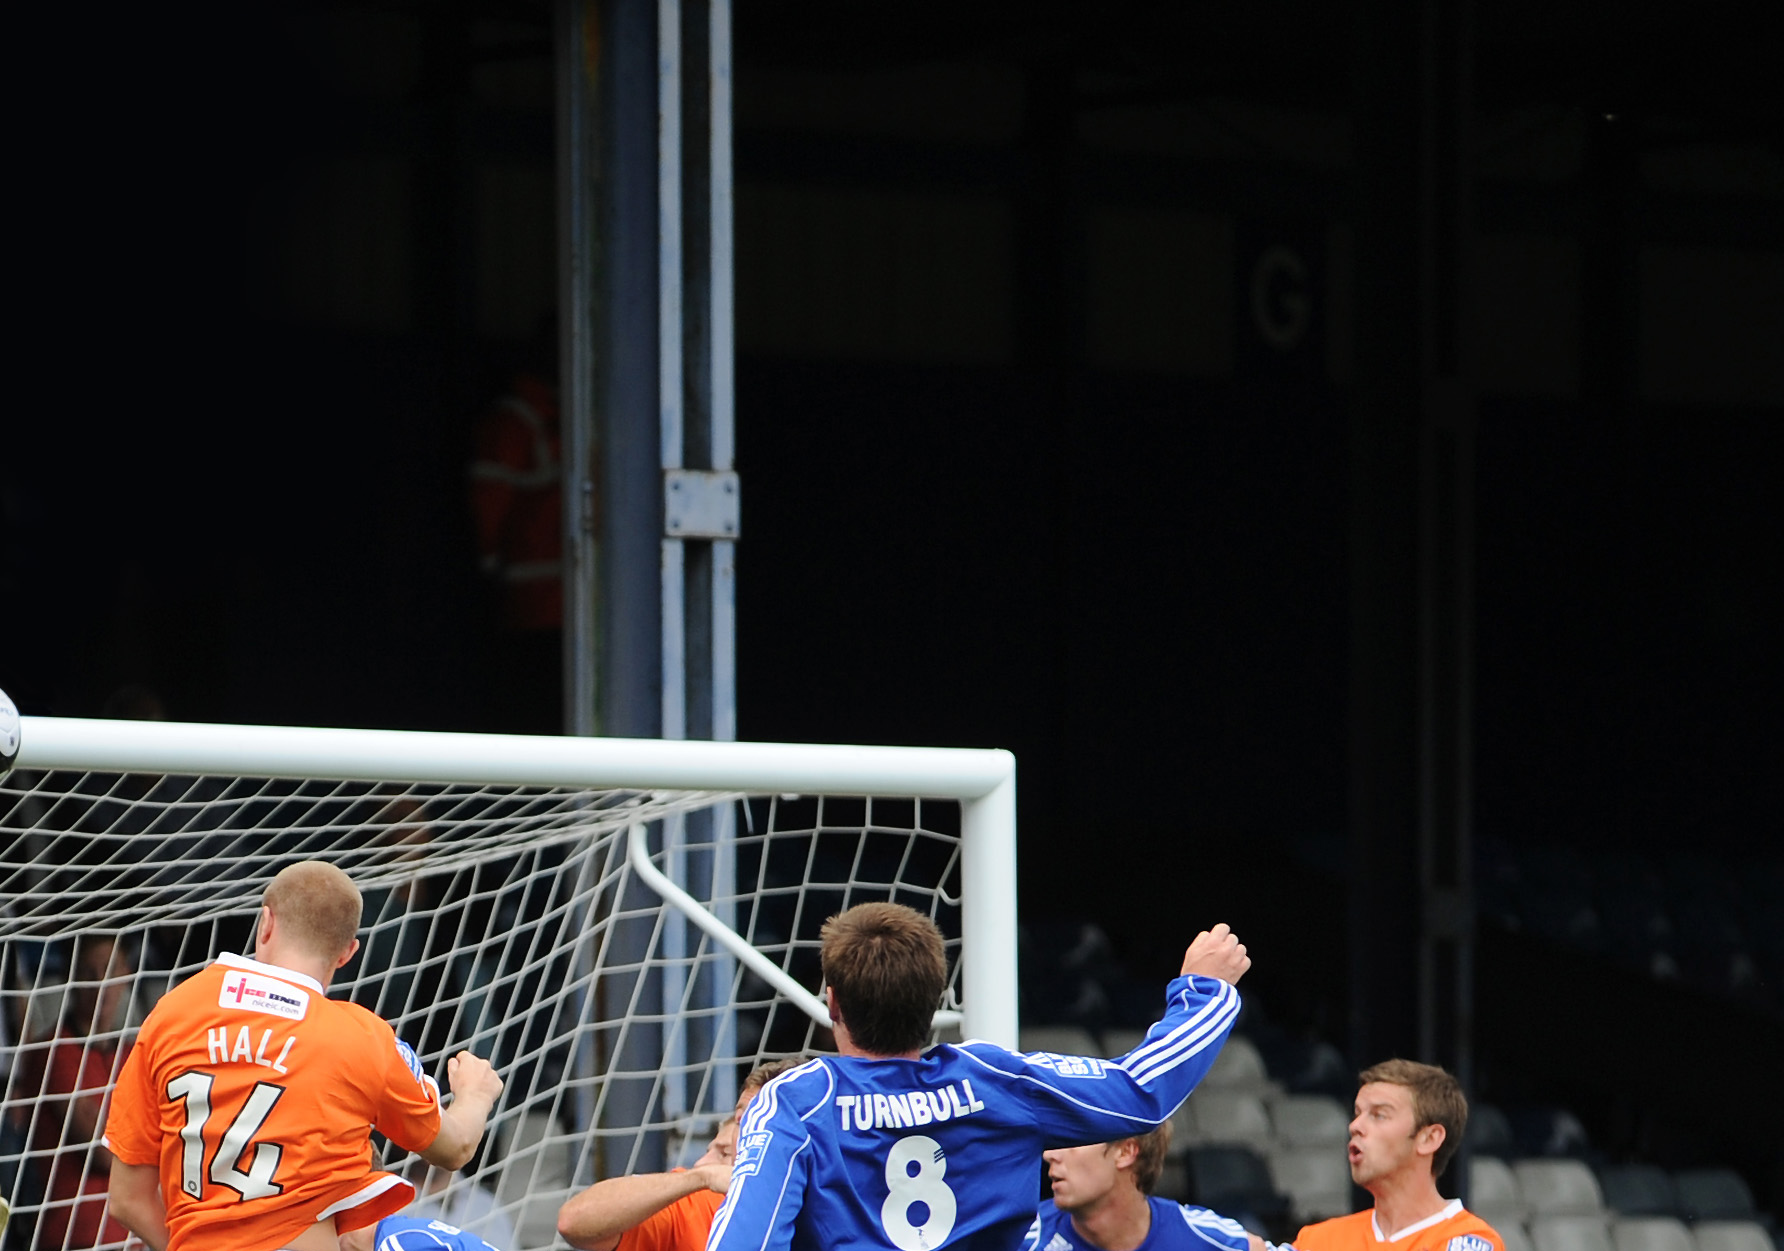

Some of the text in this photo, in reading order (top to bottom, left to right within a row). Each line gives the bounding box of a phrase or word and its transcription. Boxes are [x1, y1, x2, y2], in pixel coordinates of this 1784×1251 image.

[1251, 246, 1311, 350] G
[208, 1025, 296, 1074] HALL
[167, 1070, 286, 1201] 14
[836, 1079, 985, 1131] TURNBULL
